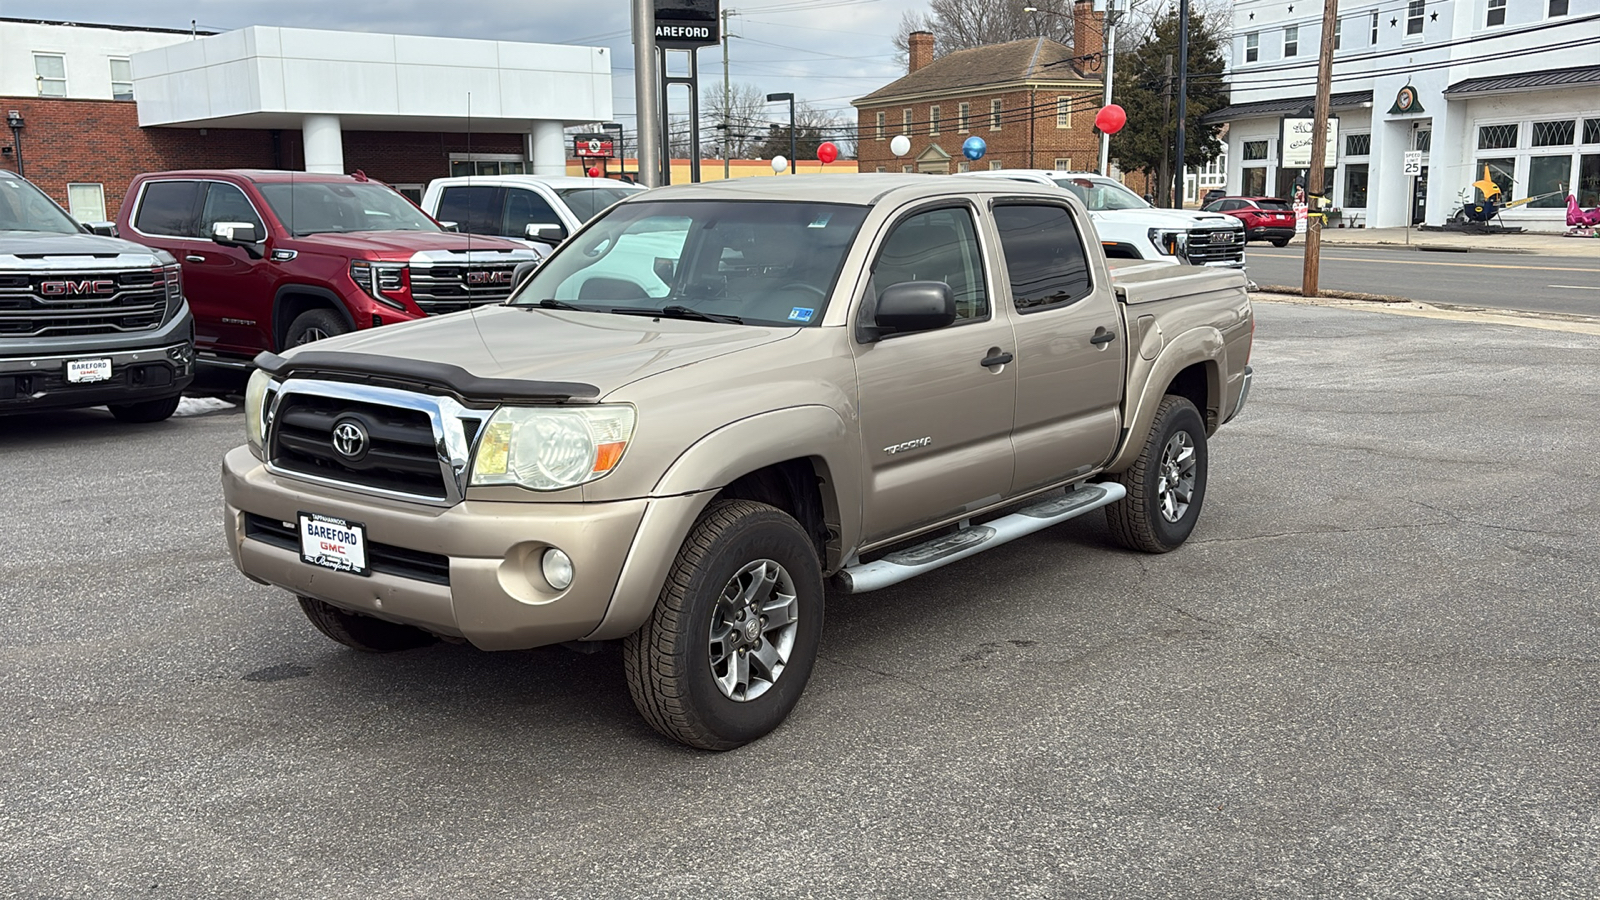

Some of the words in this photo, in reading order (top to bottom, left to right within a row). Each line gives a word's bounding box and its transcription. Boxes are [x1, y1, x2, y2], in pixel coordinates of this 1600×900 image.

[655, 26, 709, 38] AREFORD
[1405, 163, 1419, 173] 25
[467, 271, 513, 283] GMC
[41, 280, 114, 295] GMC
[71, 362, 107, 370] BAREFORD
[883, 436, 931, 455] TACOMA
[307, 523, 357, 546] BAREFORD
[320, 541, 346, 555] GMC
